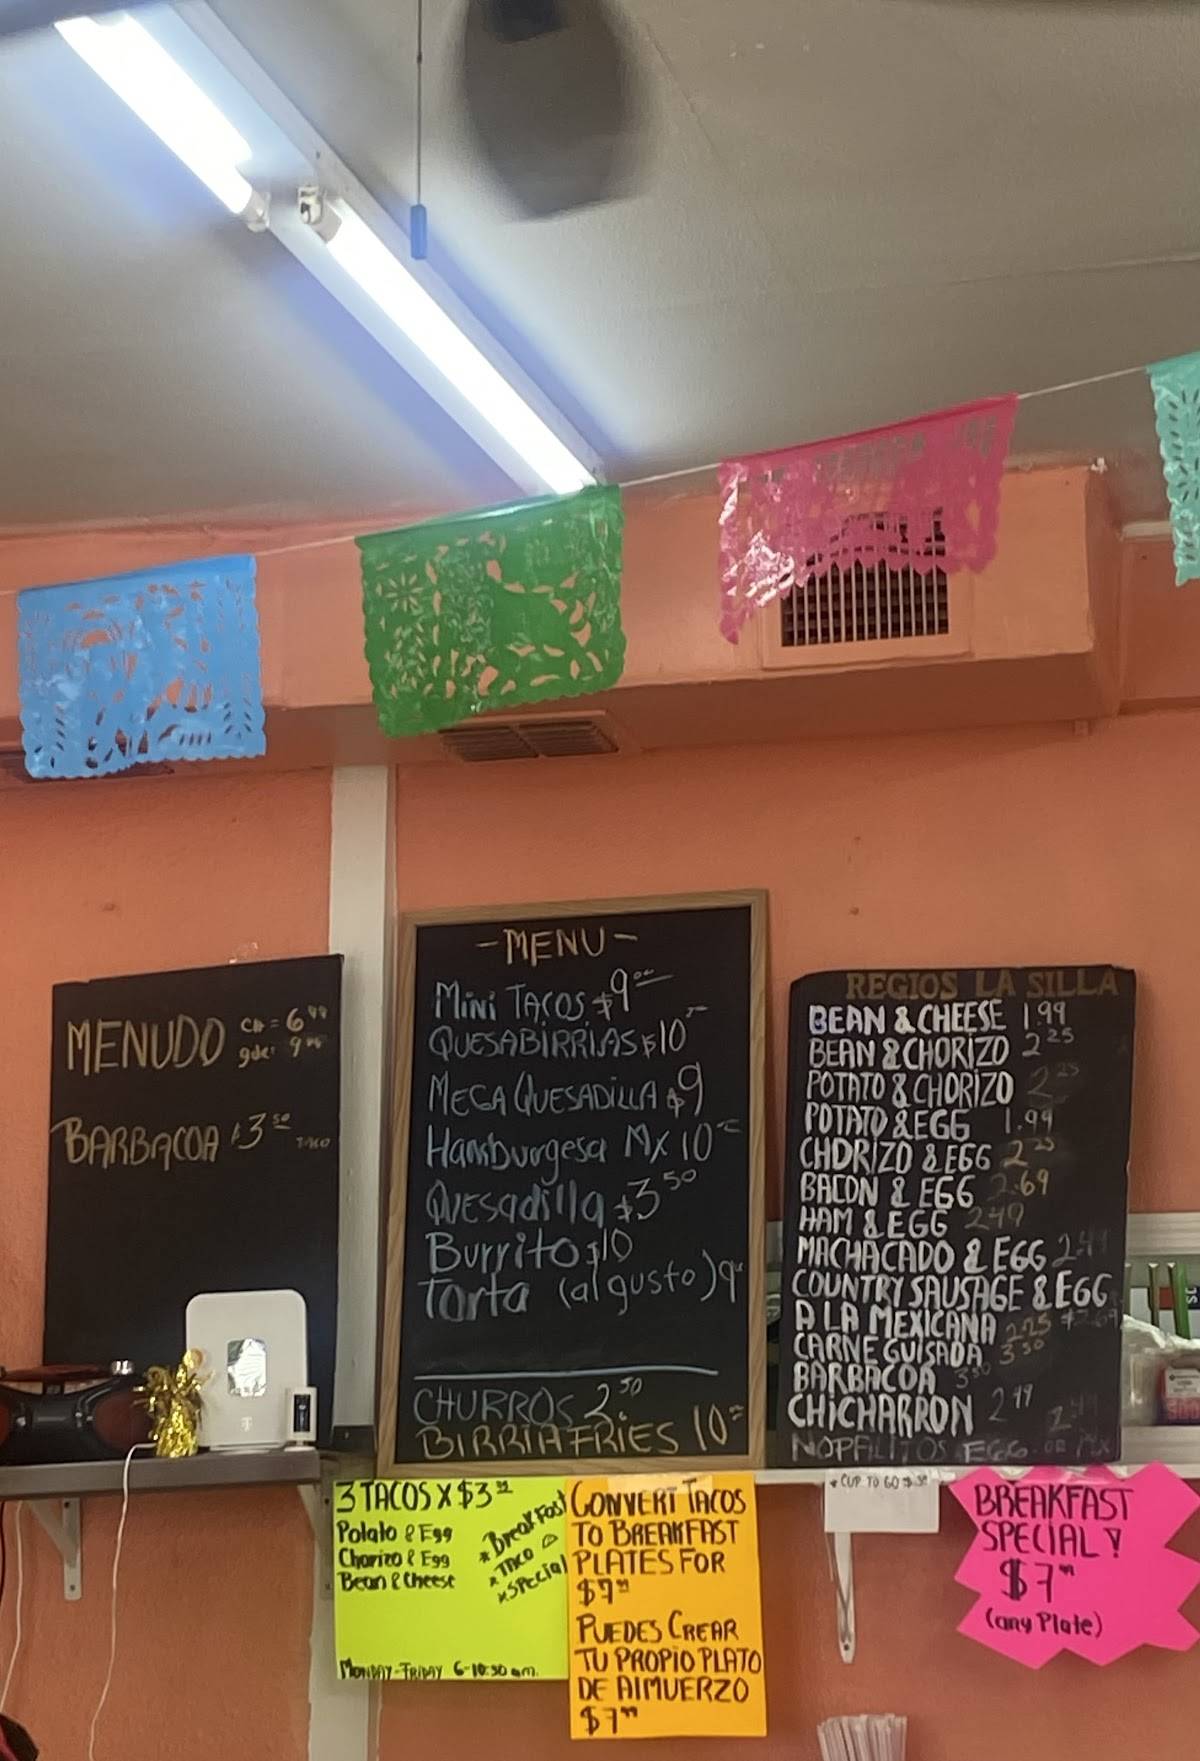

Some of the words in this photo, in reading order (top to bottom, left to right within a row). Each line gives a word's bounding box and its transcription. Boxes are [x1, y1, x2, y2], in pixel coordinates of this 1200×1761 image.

[506, 984, 585, 1021] TACOS
[846, 972, 958, 1000] REGIOS
[974, 971, 1016, 998] LA
[1026, 969, 1119, 998] SILLA
[808, 1004, 886, 1035] BEAN
[917, 999, 1007, 1034] CHEESE
[66, 1013, 226, 1077] MENUDO
[808, 1038, 876, 1068] BEAN
[902, 1032, 1010, 1070] CHORIZO
[514, 1070, 657, 1117] QUESADILLA
[806, 1069, 886, 1103] POTATO
[913, 1068, 1014, 1108] CHORIZO
[804, 1102, 888, 1136] POTATO
[914, 1108, 971, 1141] EGG
[50, 1116, 220, 1171] BARBACOA
[425, 1123, 606, 1185] Hamburgesa
[800, 1136, 913, 1175] CHORIZO
[944, 1143, 992, 1174] EGG
[800, 1171, 878, 1206] BACON
[920, 1174, 976, 1209] EGG
[799, 1207, 853, 1235] HAM
[888, 1208, 949, 1239] EGG
[424, 1228, 580, 1274] Burrito
[797, 1236, 955, 1274] MACHACADO
[993, 1236, 1047, 1273] EGG
[417, 1273, 531, 1322] Torta
[792, 1268, 904, 1303] COUNTRY
[911, 1274, 1025, 1312] SAUSAGE
[1055, 1269, 1113, 1308] EGG
[795, 1300, 815, 1331] A
[824, 1300, 859, 1332] LA
[869, 1305, 997, 1345] MEXICANA
[793, 1333, 879, 1365] CARNE
[882, 1338, 983, 1367] GUISADA
[793, 1361, 936, 1395] BARBACOA
[413, 1385, 577, 1428] CHURROS
[787, 1393, 975, 1439] CHICHARRON
[415, 1421, 562, 1461] BIRRIA
[336, 1481, 356, 1513] 3
[360, 1481, 431, 1511] TACOS
[571, 1480, 677, 1518] CONVERT
[682, 1478, 747, 1514] TACOS
[974, 1484, 1134, 1521] BREAKFAST
[418, 1523, 453, 1544] Egg
[572, 1520, 604, 1547] TO
[608, 1519, 740, 1547] BREAKFAST
[420, 1550, 451, 1568] Egg
[572, 1548, 674, 1576] PLATES
[679, 1547, 726, 1574] FOR
[337, 1572, 387, 1592] Bean
[576, 1613, 662, 1644] PUEDES
[668, 1610, 739, 1641] CREAR
[574, 1647, 608, 1672] TU
[615, 1645, 696, 1673] PROPIO
[699, 1647, 762, 1674] PLATO
[577, 1676, 609, 1701] DE
